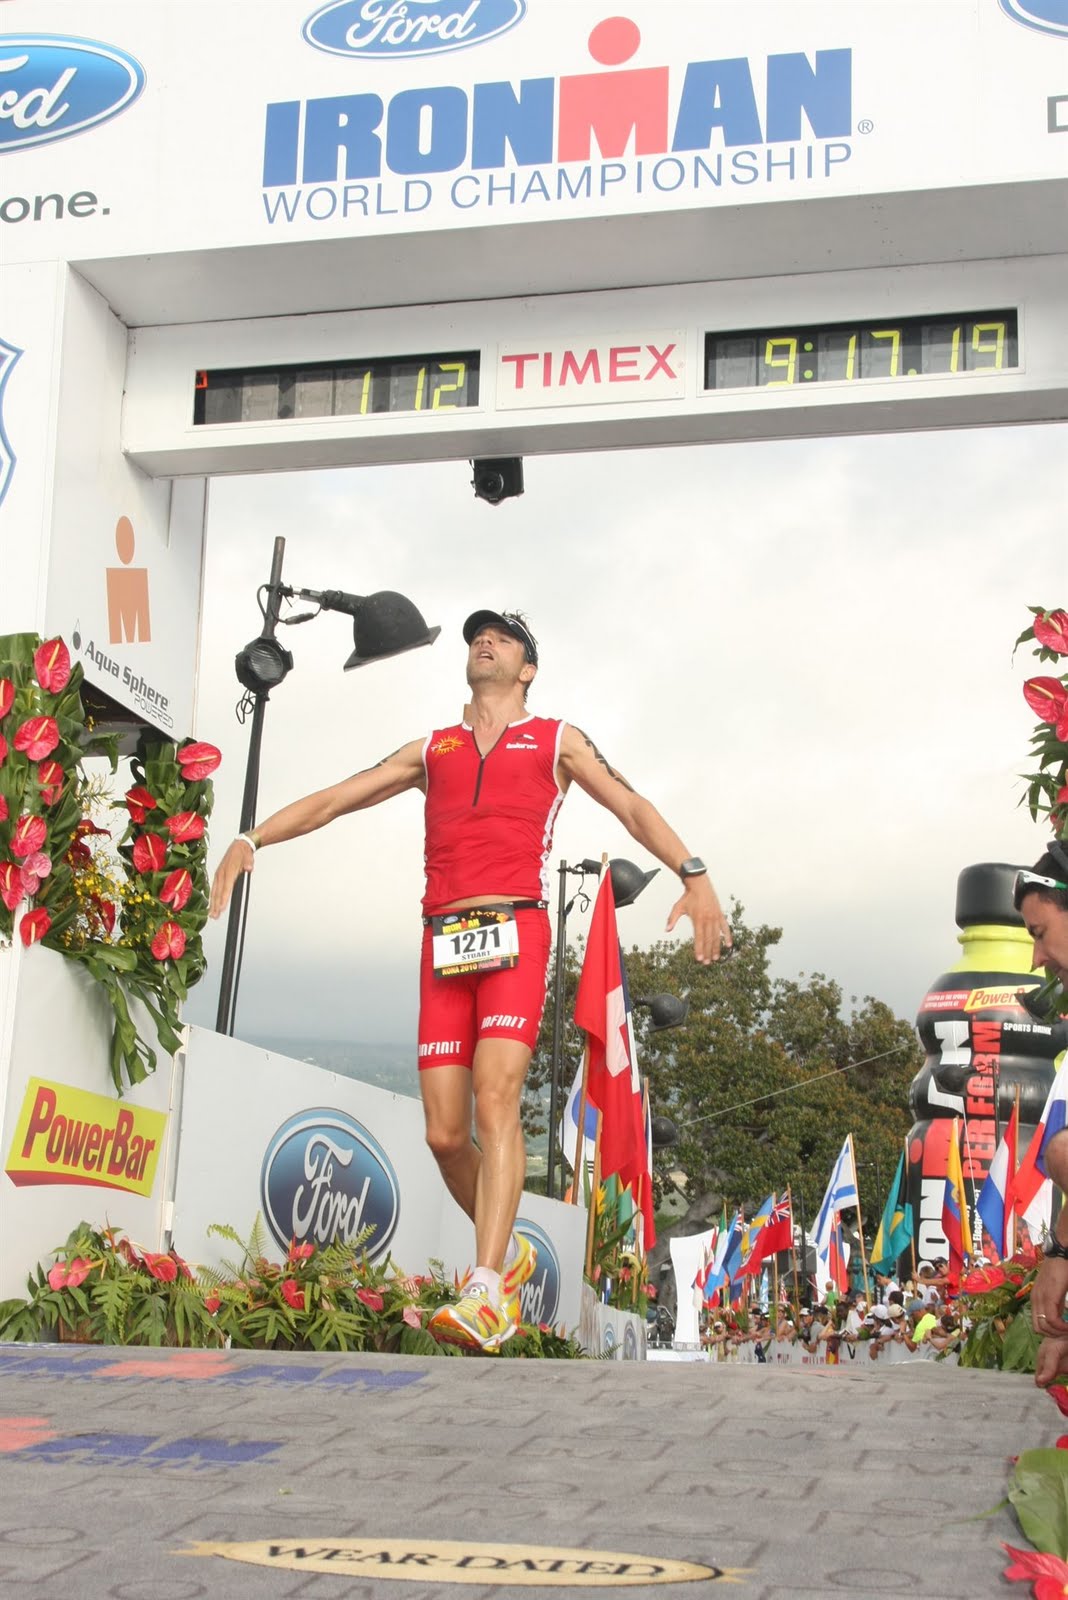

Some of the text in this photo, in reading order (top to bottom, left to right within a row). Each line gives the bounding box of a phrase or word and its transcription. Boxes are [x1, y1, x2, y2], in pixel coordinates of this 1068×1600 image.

[345, 0, 477, 48] Ford
[261, 17, 853, 188] IRONMAN
[262, 142, 852, 224] WORLD CHAMPIONSHIP
[0, 191, 110, 224] one.
[501, 343, 677, 390] TIMEX
[84, 640, 169, 712] Aqua Sphere
[134, 694, 174, 730] POWERED
[450, 926, 501, 956] 1271
[461, 950, 491, 961] STUART
[460, 962, 478, 973] 2010
[970, 987, 1025, 1007] Power
[481, 1014, 527, 1030] INFINIT
[1003, 1022, 1052, 1036] SPORTS DRINK
[418, 1040, 462, 1057] INFINIT
[21, 1085, 155, 1182] PowerBar
[292, 1133, 371, 1245] Ford
[266, 1544, 667, 1578] WEAR-DATED
